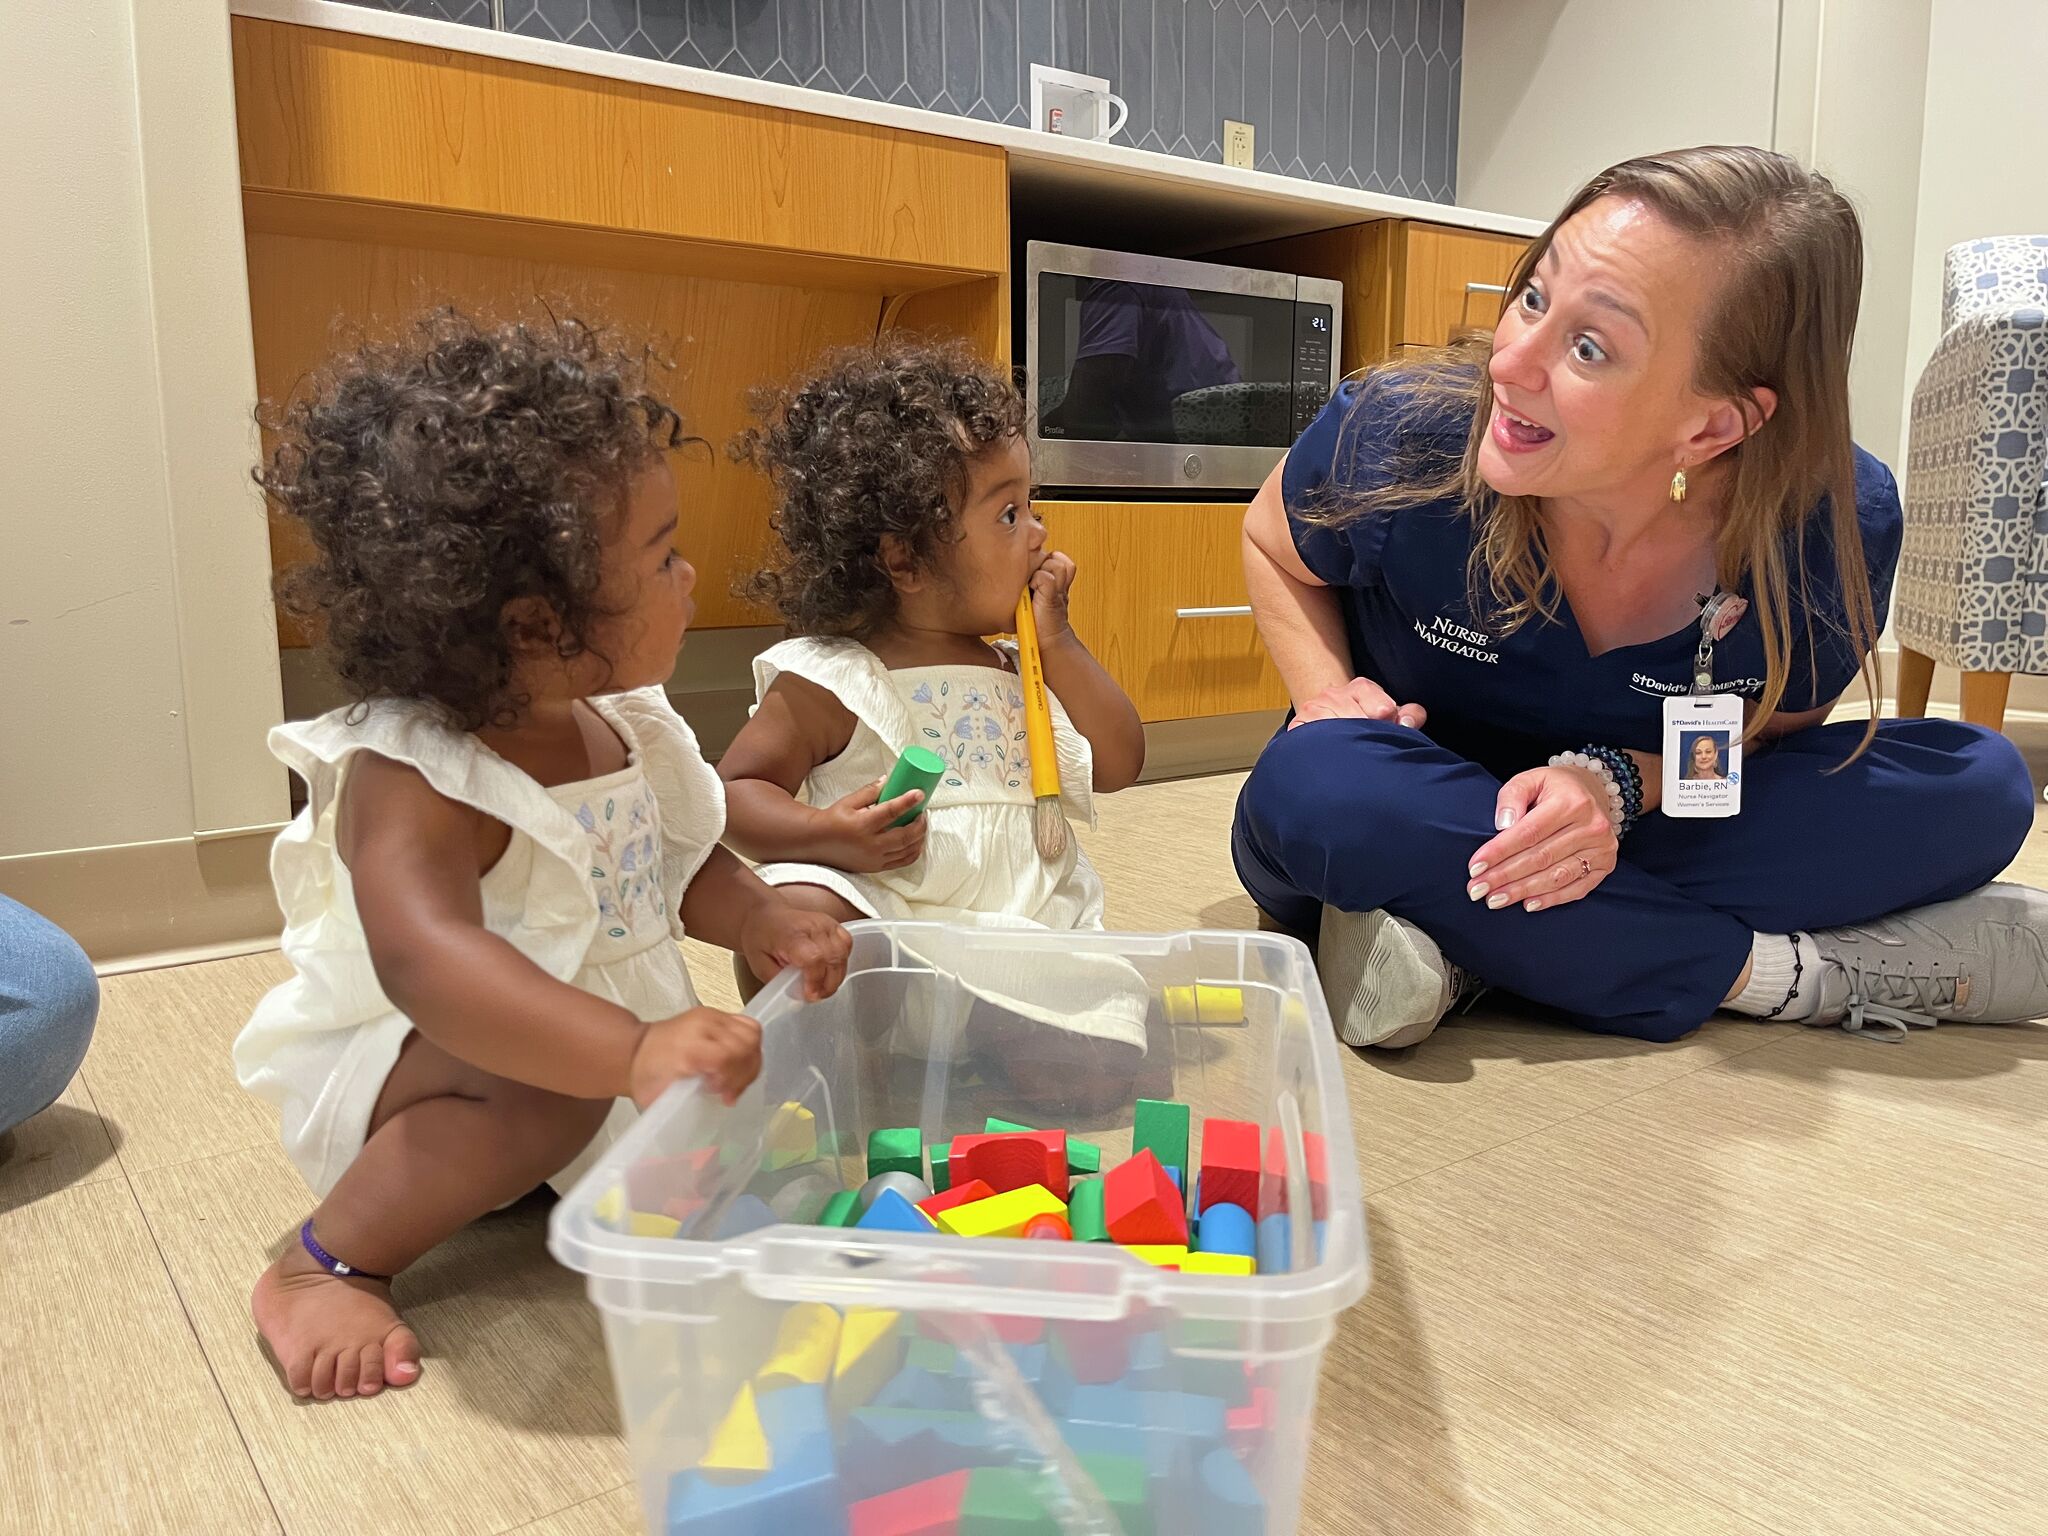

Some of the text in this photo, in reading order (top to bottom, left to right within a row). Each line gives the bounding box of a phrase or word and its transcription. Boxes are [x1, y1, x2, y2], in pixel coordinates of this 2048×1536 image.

[1413, 617, 1499, 664] NAVIGATOR
[1431, 615, 1489, 646] NURSE
[1679, 782, 1728, 791] Barbie, RN
[1698, 793, 1729, 801] Navigator
